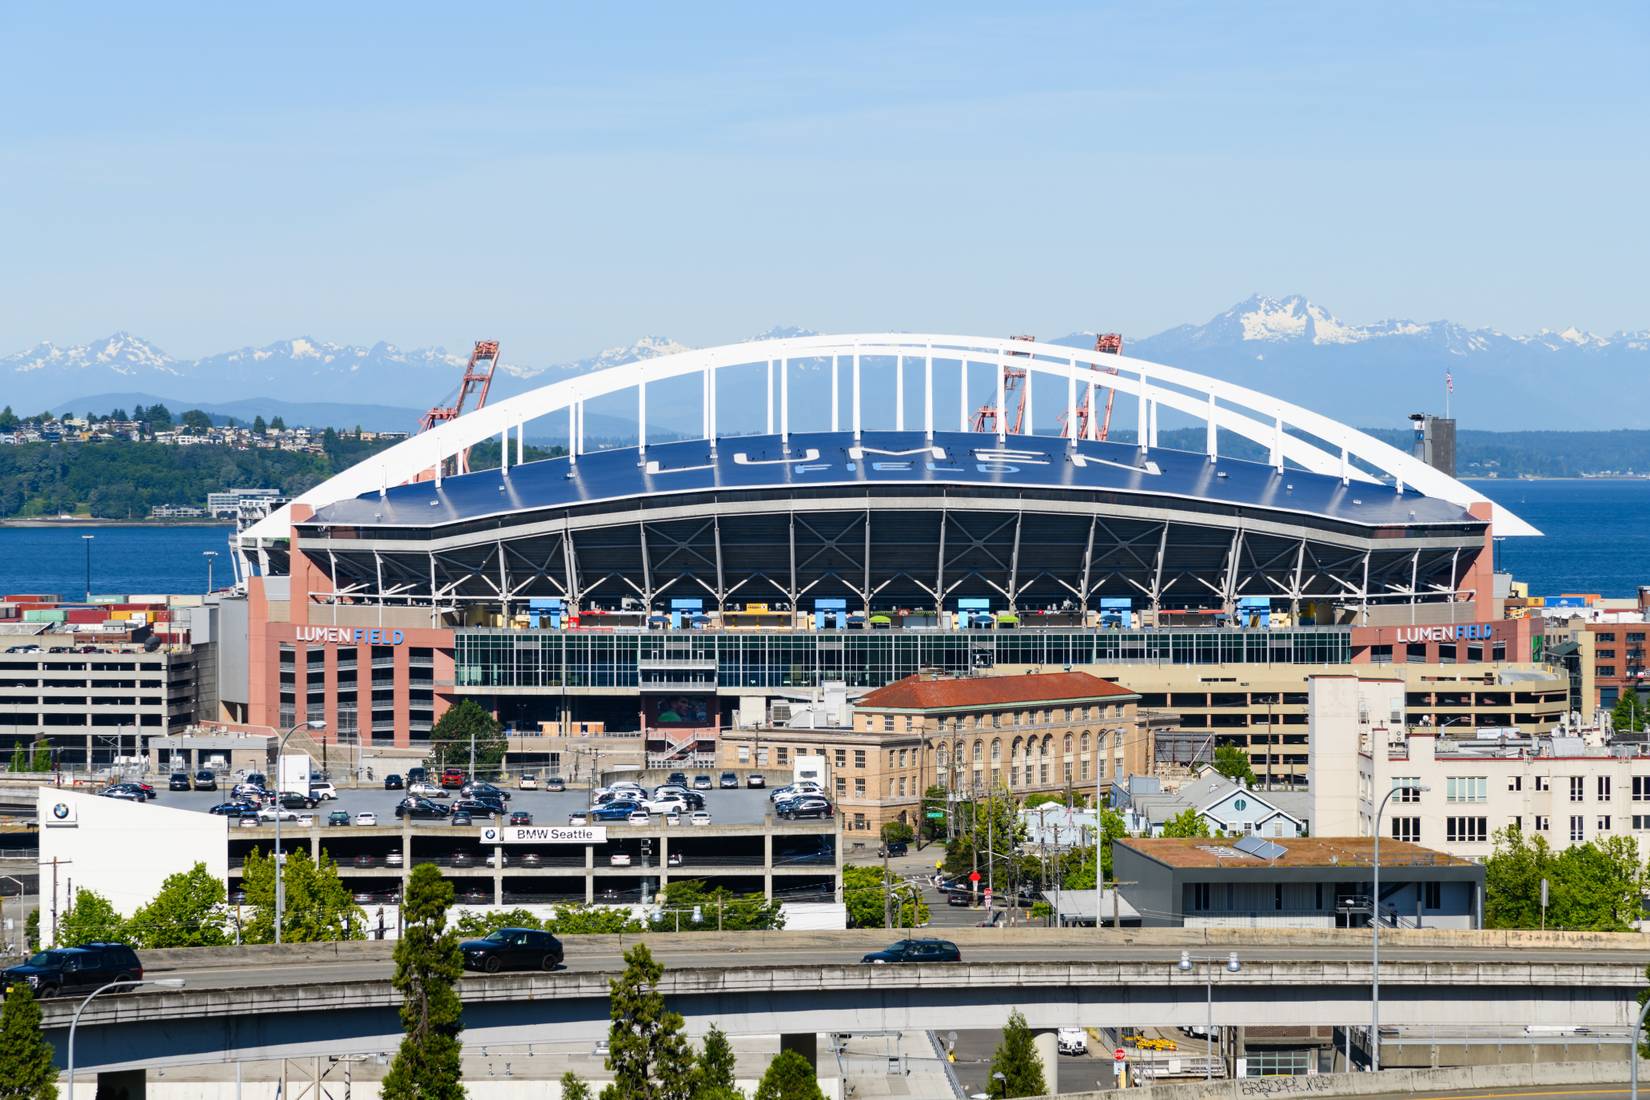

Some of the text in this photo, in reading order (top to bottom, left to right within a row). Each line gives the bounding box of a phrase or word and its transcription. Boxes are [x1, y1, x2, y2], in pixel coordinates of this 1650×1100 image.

[646, 446, 1162, 475] LUMEN
[795, 461, 1021, 475] FIELD
[296, 626, 404, 645] LUMEN FIELD
[1397, 624, 1493, 643] LUMEN FIELD
[517, 829, 593, 839] BMW Seattle
